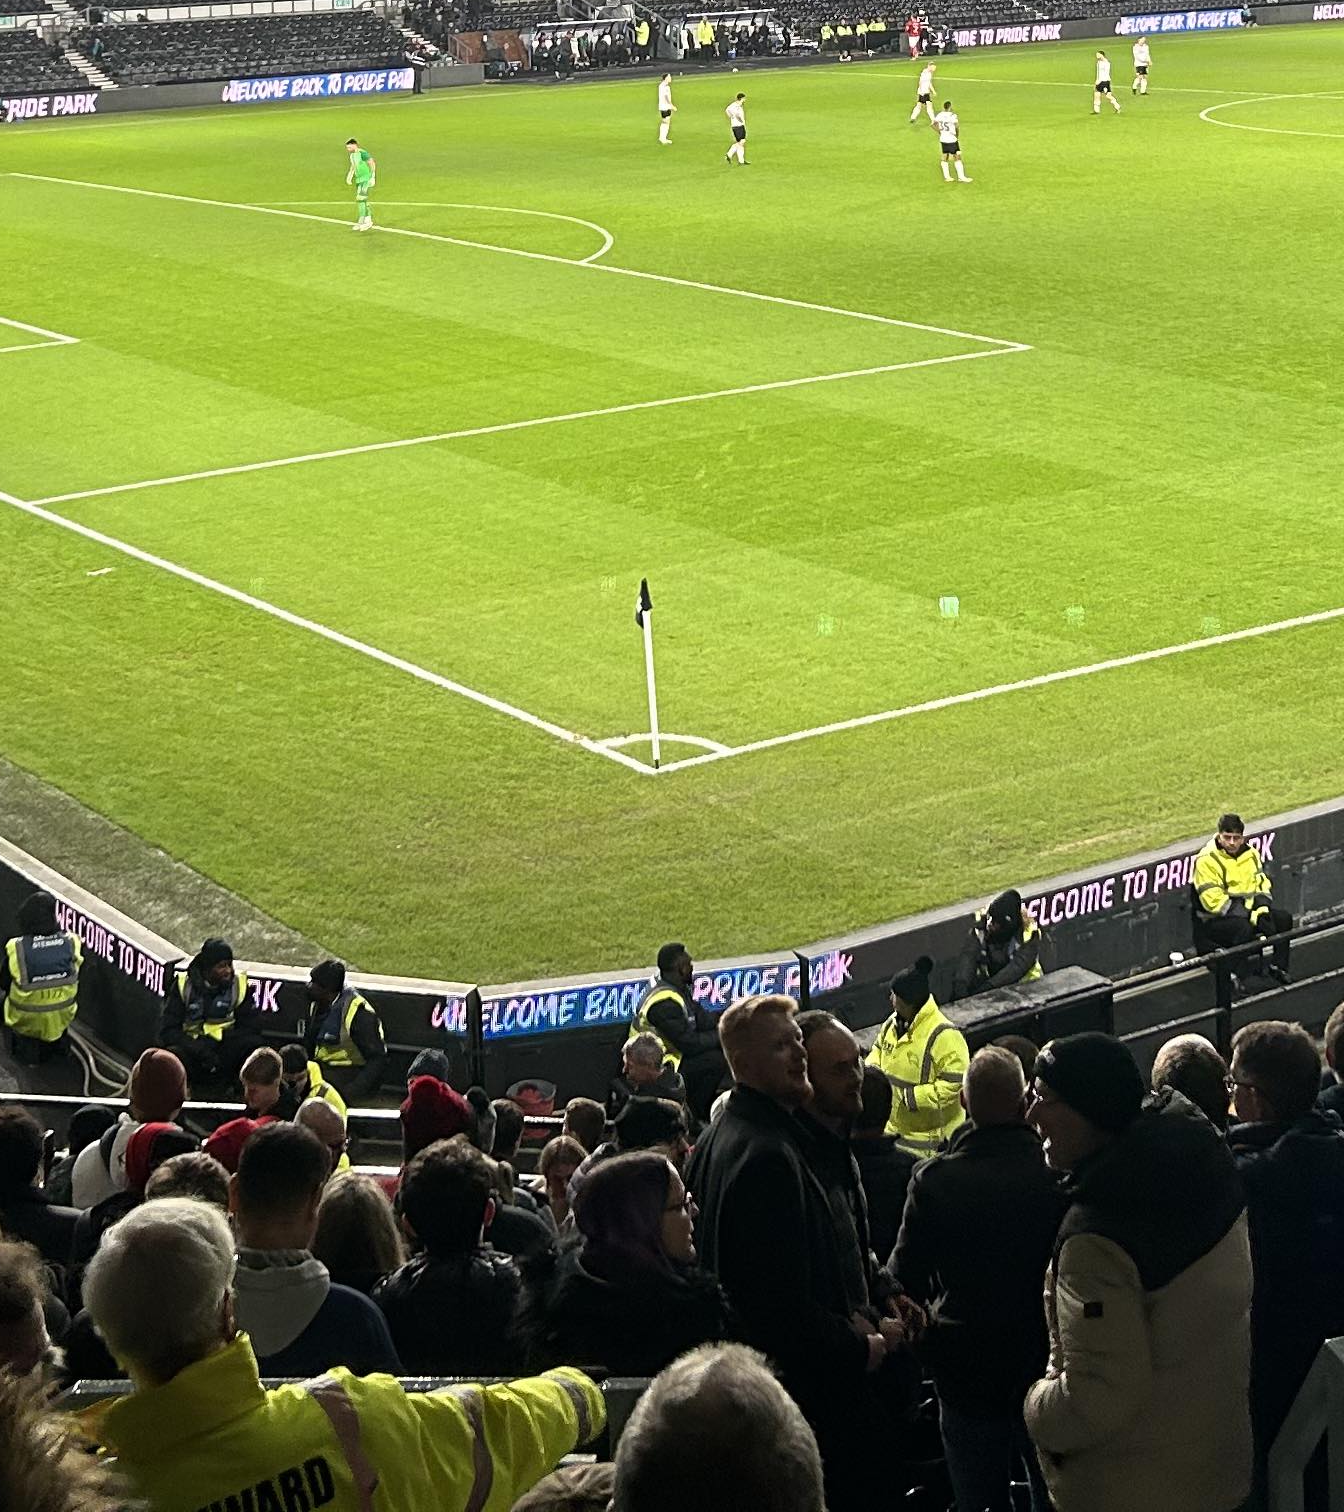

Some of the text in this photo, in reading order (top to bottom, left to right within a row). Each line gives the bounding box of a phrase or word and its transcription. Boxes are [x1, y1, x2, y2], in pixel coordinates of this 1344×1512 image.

[979, 29, 994, 45] TO
[996, 26, 1030, 44] PRIDE
[1031, 24, 1061, 41] PARK
[53, 93, 97, 115] PARK
[222, 80, 288, 102] WELCOME
[290, 79, 324, 97] BACK
[327, 75, 342, 94] TO
[344, 73, 386, 92] PRIDE
[1022, 878, 1115, 926] ELCOME
[1122, 870, 1147, 902] TO
[56, 899, 114, 963] WELCOME
[118, 940, 134, 975] TO
[693, 965, 779, 1002] PRIDE
